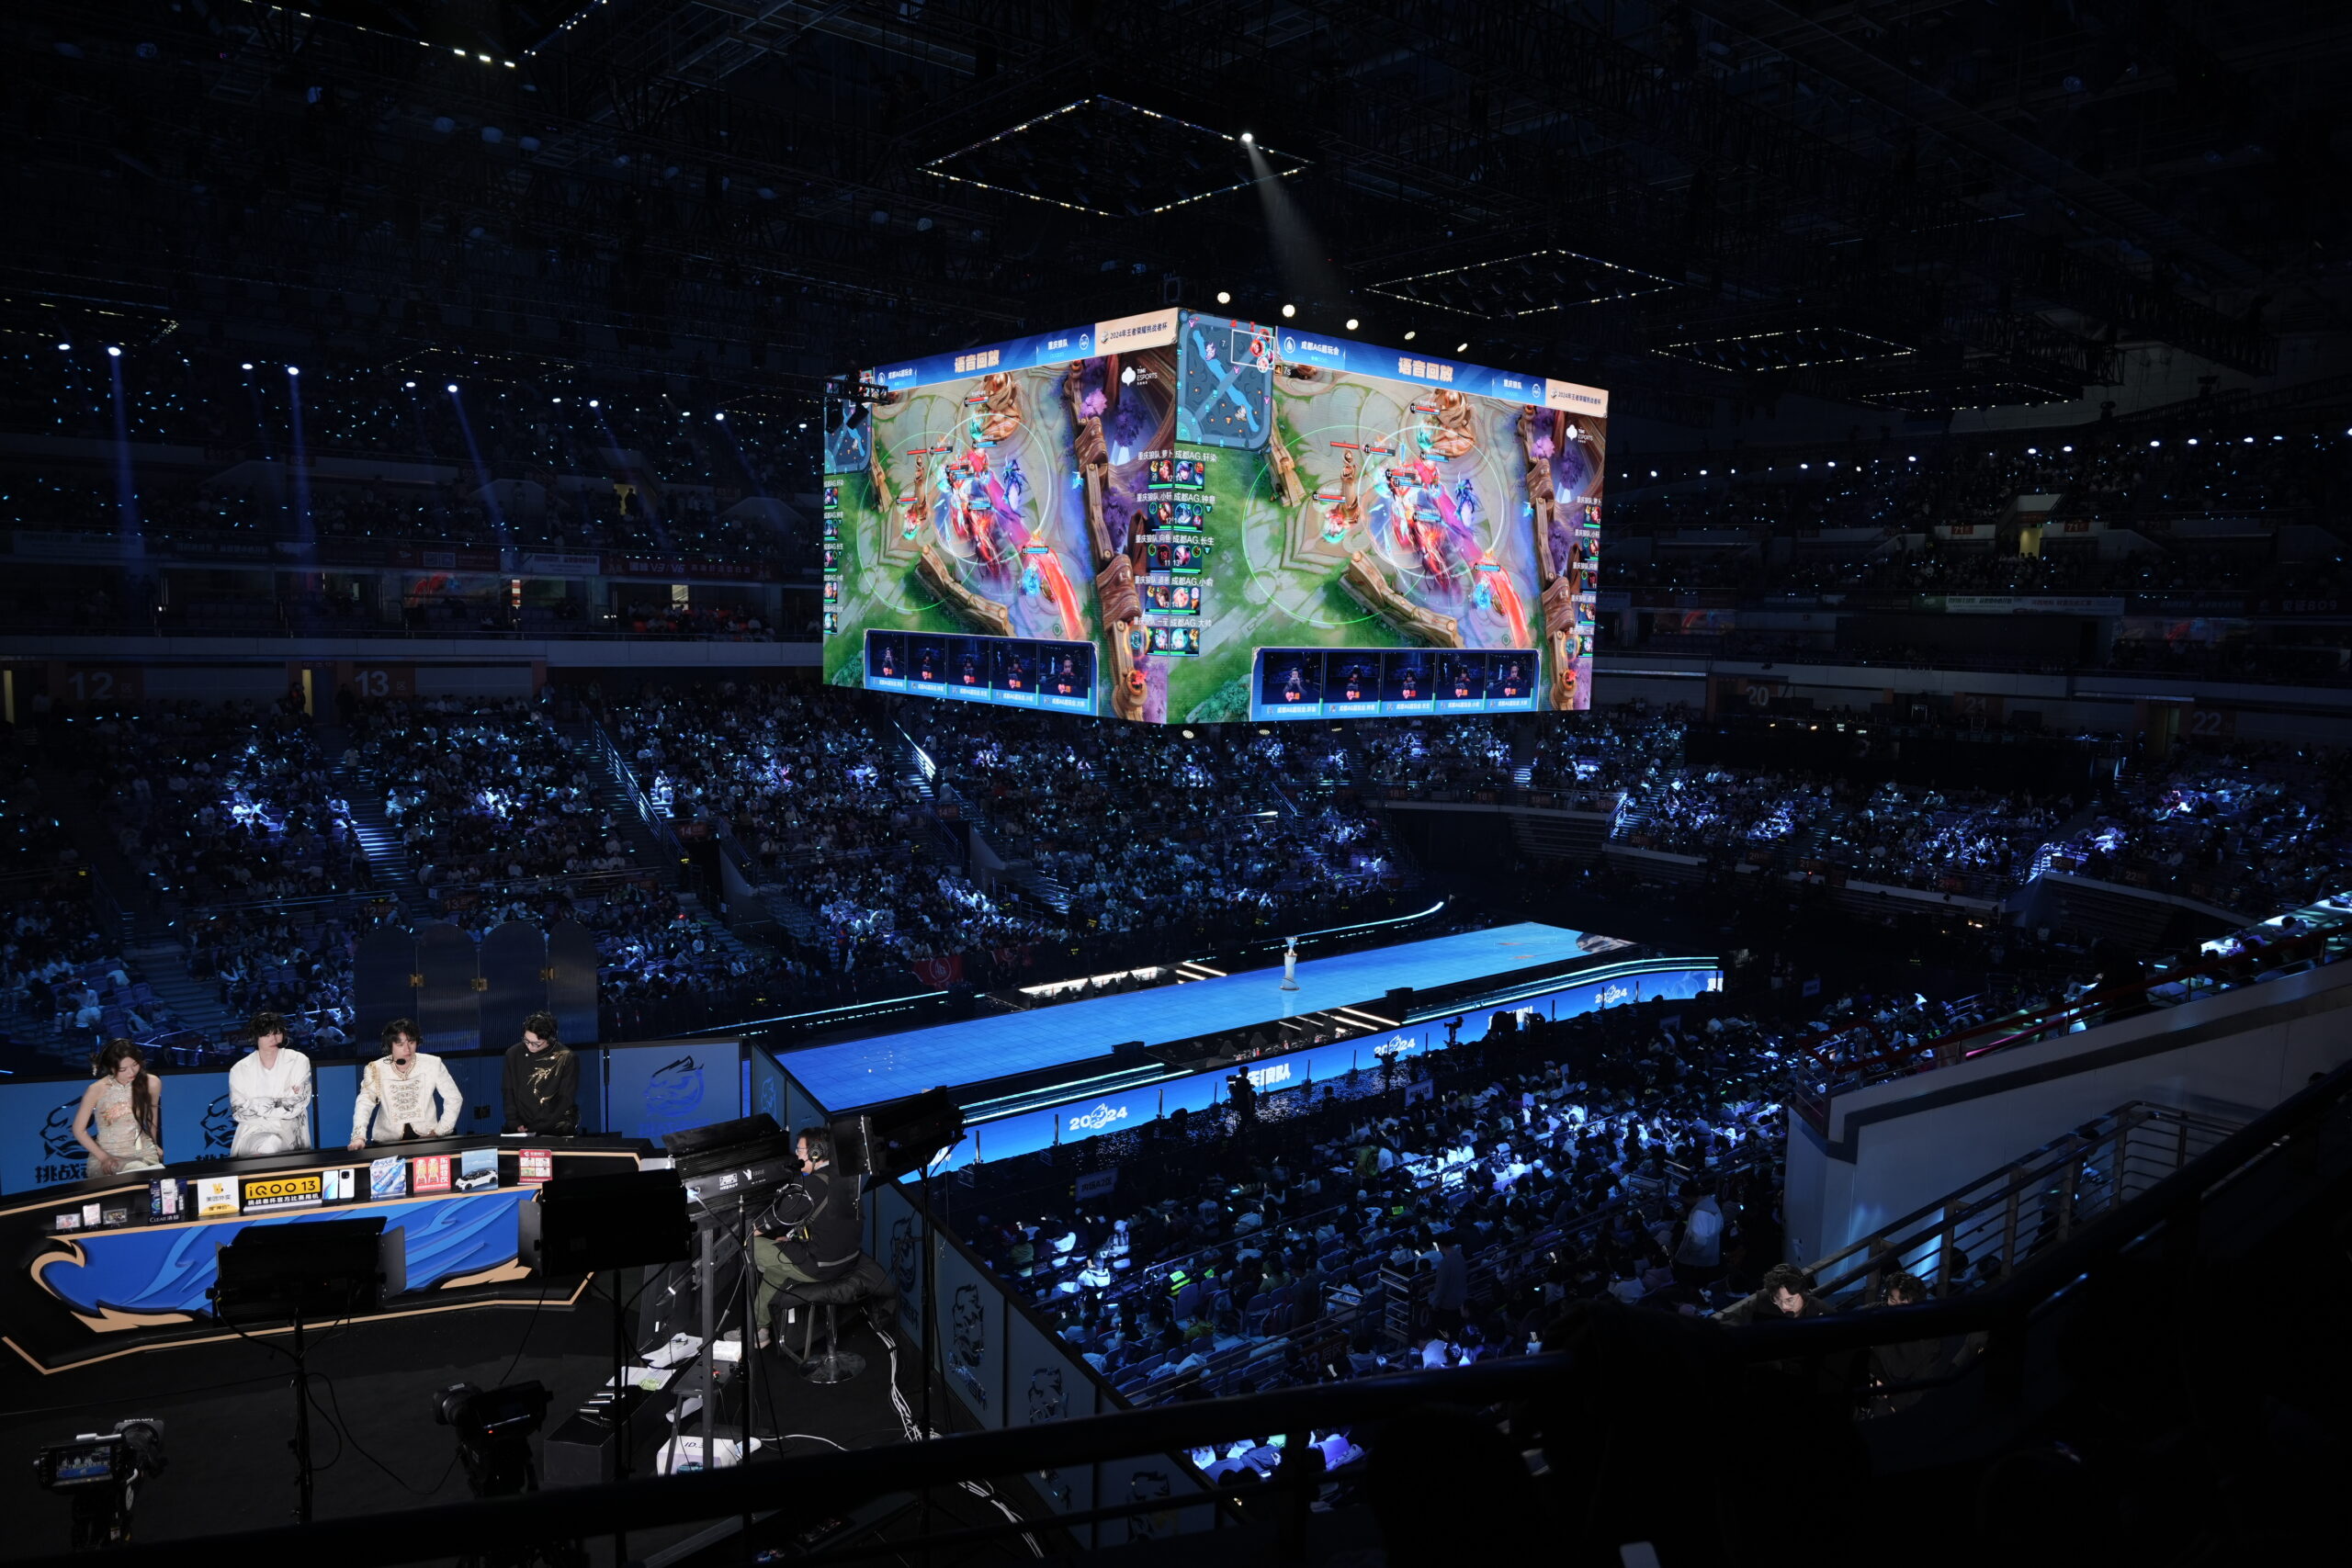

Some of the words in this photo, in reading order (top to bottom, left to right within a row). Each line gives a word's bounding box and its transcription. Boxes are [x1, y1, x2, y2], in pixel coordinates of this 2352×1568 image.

[1110, 322, 1168, 339] 2024年王者荣耀挑战者杯
[1301, 341, 1340, 355] 成都AG超玩会
[955, 349, 1000, 373] 语音回放
[1398, 356, 1453, 382] 语音回放
[1136, 373, 1158, 381] ESPORTS
[1172, 535, 1215, 546] 成都AG.长生
[68, 671, 114, 700] 12
[355, 671, 390, 697] 13
[1747, 686, 1770, 705] 20
[2191, 711, 2222, 736] 22
[1069, 1106, 1128, 1131] 2024
[249, 1183, 296, 1197] iQOO
[301, 1180, 316, 1191] 13
[247, 1193, 319, 1206] 挑战者杯官方比赛用机
